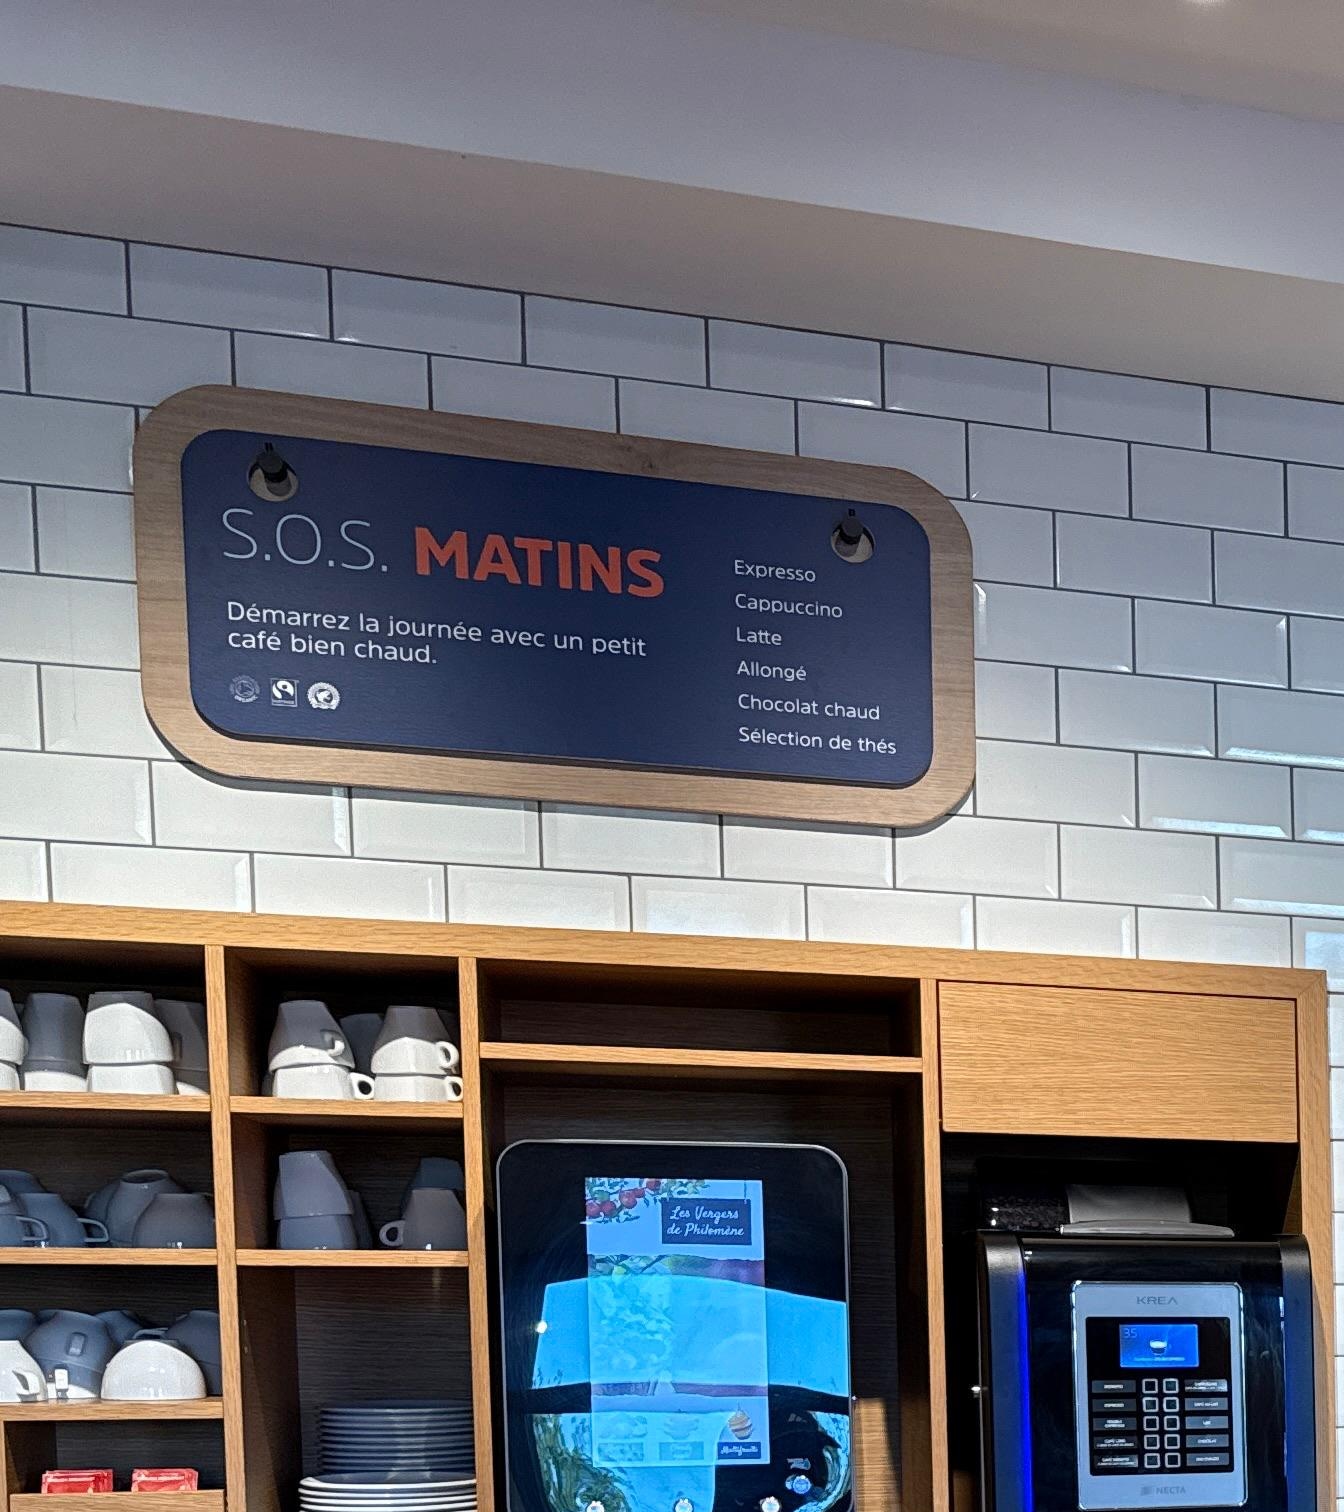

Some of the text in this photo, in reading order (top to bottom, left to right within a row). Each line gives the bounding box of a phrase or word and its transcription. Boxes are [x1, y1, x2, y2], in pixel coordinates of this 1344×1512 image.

[222, 507, 665, 598] S.O.S. MATINS
[734, 559, 817, 583] Expresso
[735, 593, 844, 618] Cappuccino
[227, 600, 647, 657] Démarrez la journée avec un petit
[736, 626, 782, 646] Latte
[227, 630, 438, 665] café bien chaud.
[736, 660, 807, 682] Allongé
[738, 693, 880, 721] Chocolat chaud
[738, 726, 897, 755] Sélection de thés
[669, 1205, 739, 1225] Les Vergers
[666, 1222, 682, 1235] de
